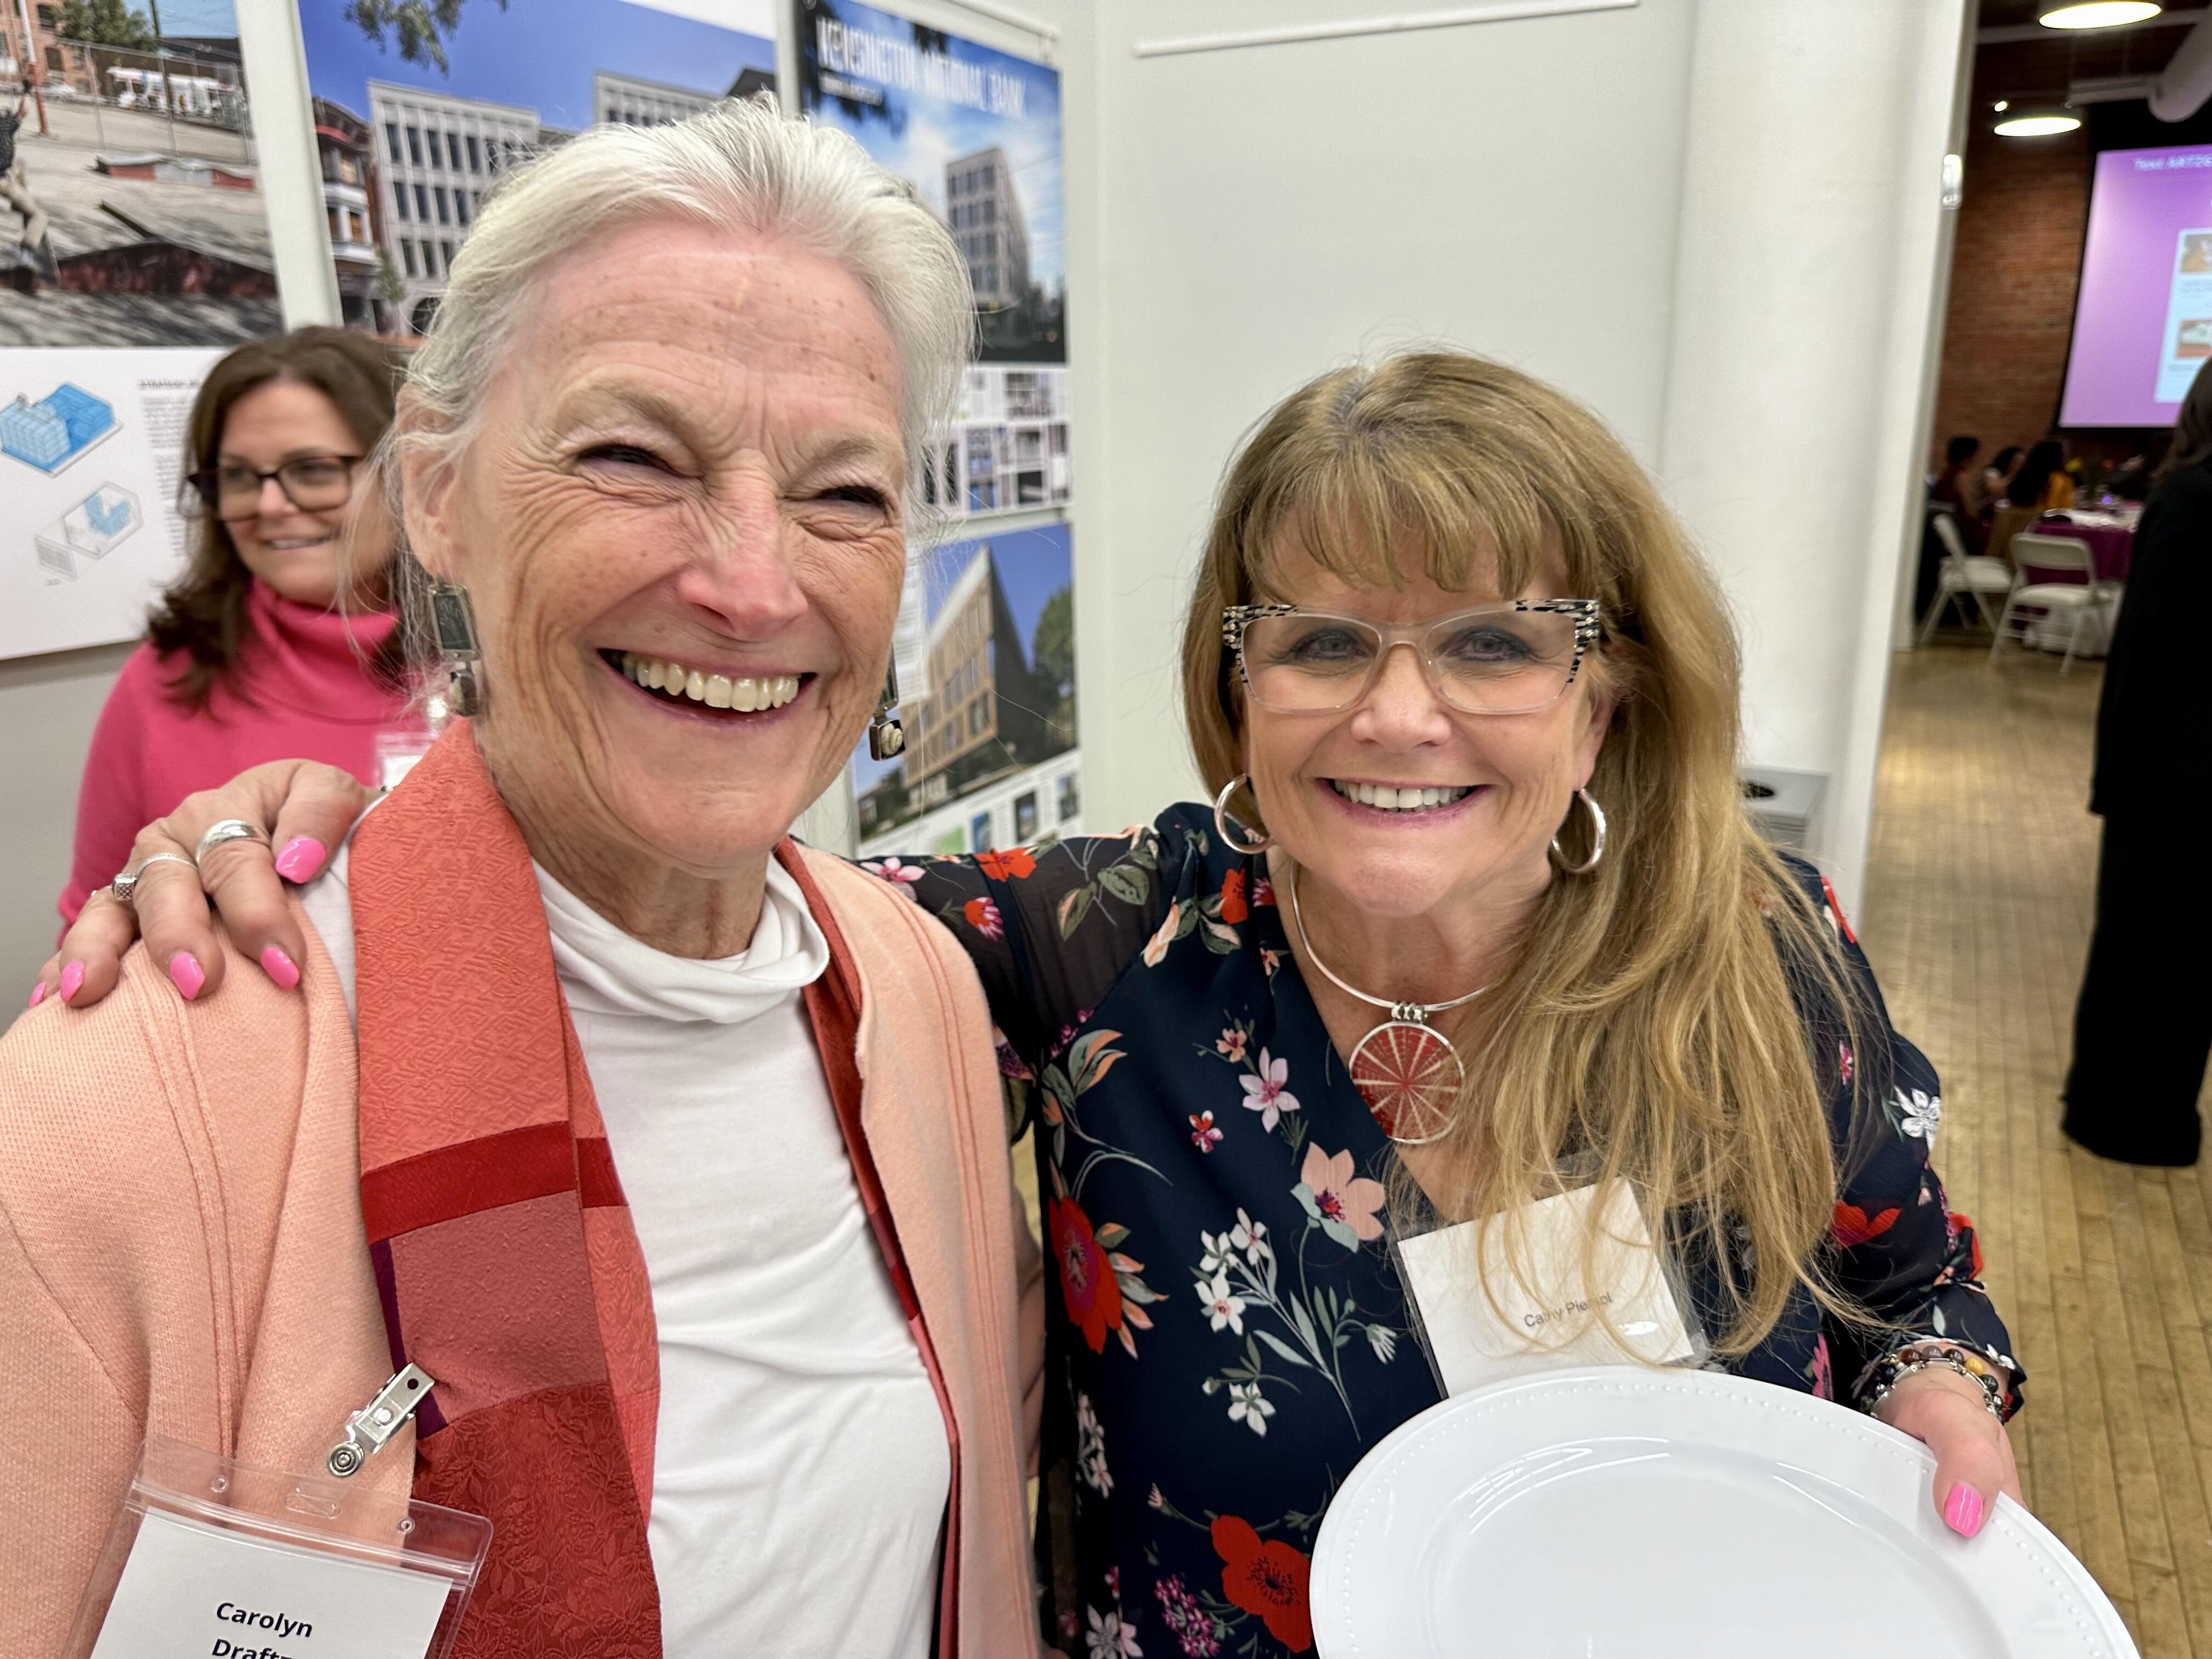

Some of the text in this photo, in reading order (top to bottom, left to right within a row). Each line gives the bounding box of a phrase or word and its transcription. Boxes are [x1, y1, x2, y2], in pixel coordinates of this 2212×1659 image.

[1565, 1292, 1612, 1315] Pieol
[217, 1602, 313, 1638] Carolyn
[212, 1638, 292, 1659] Draft
